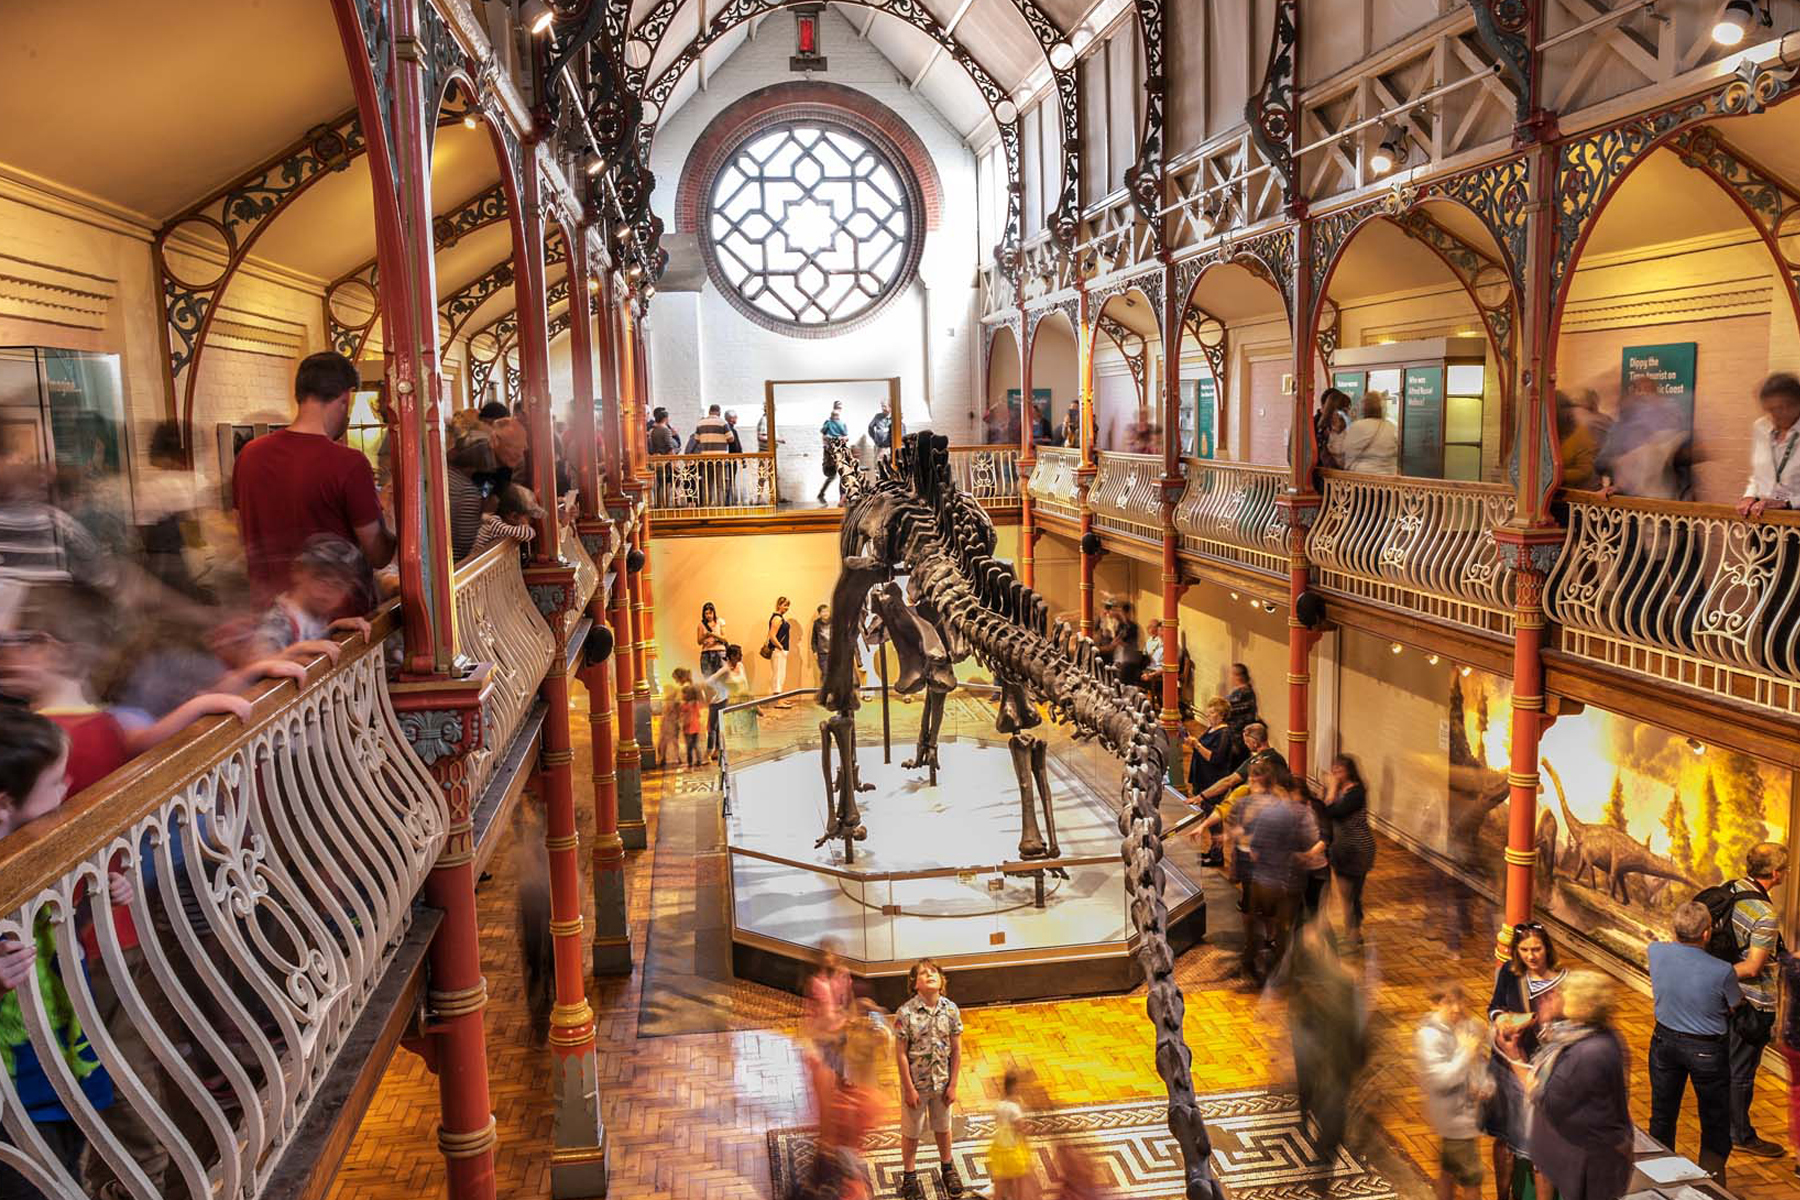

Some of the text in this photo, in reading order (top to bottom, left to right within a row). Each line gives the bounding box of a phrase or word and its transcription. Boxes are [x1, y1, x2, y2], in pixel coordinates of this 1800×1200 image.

[1629, 356, 1659, 369] Dippy the
[1667, 371, 1677, 379] on
[1665, 383, 1684, 394] Coast
